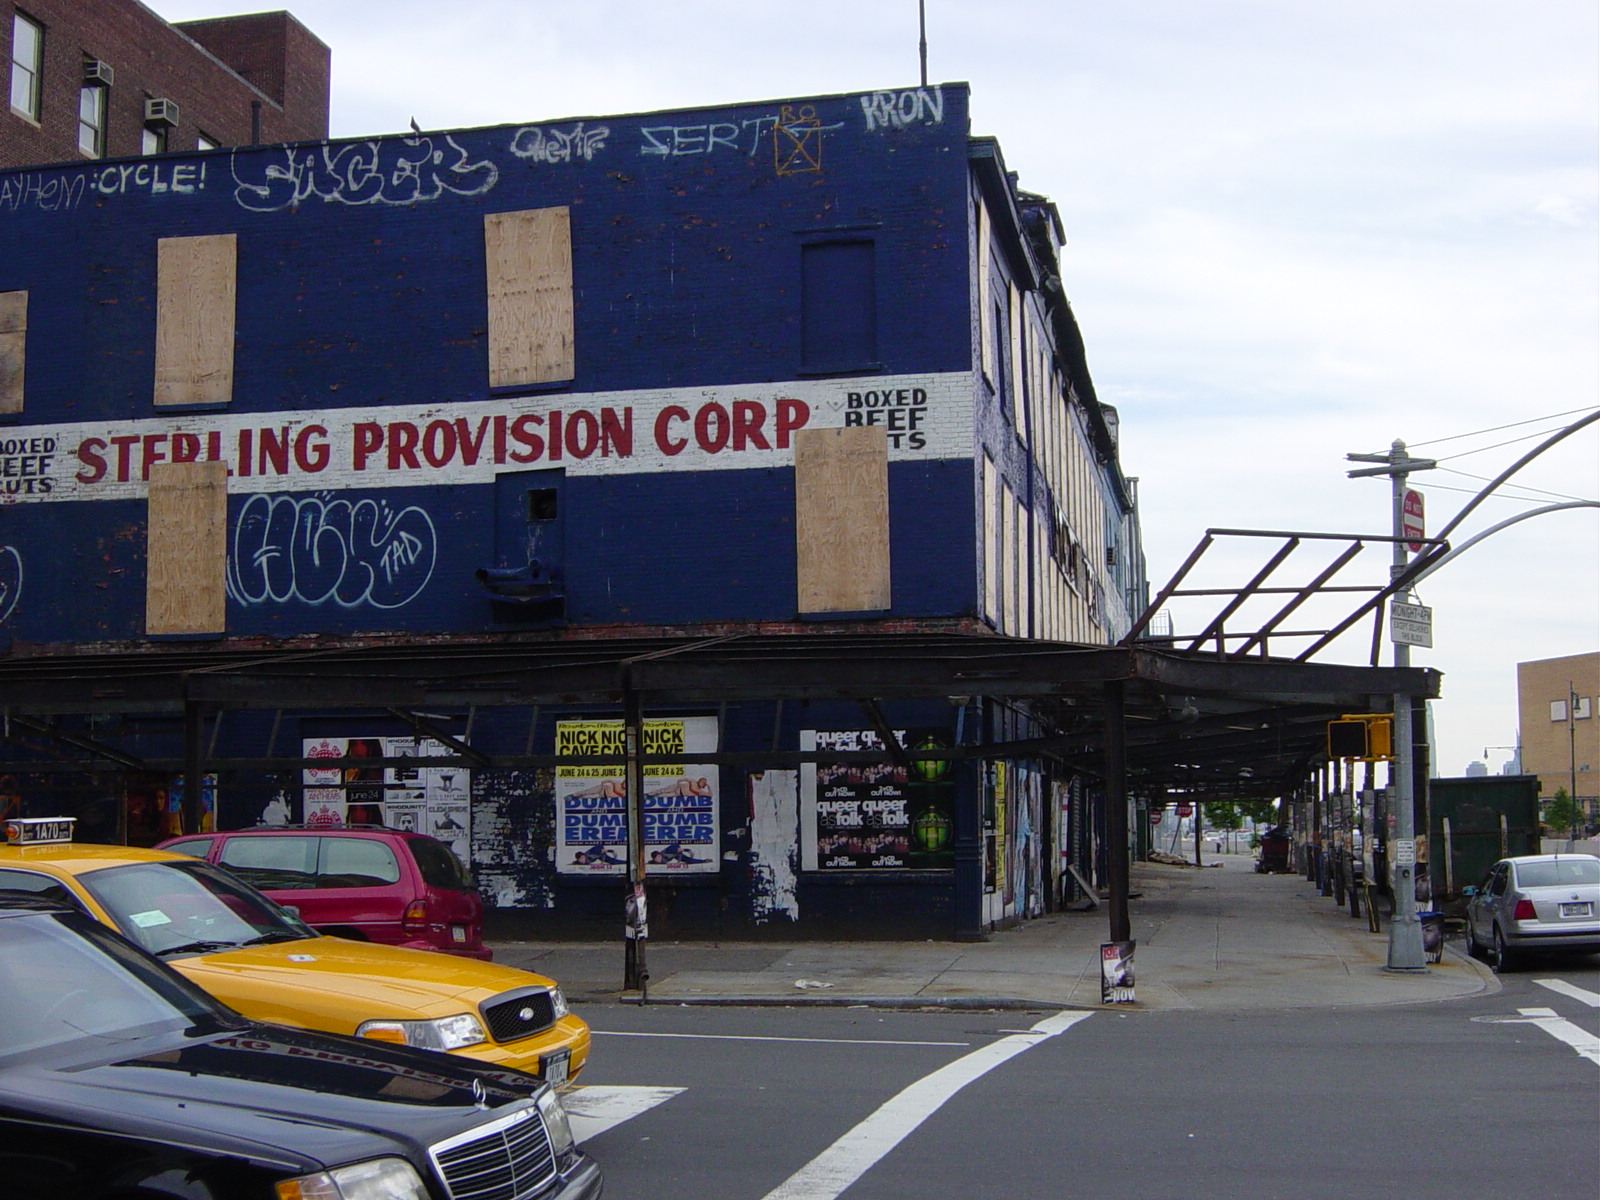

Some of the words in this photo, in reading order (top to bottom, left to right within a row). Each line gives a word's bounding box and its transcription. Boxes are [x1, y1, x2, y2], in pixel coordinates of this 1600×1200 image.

[860, 86, 944, 132] KRON
[847, 388, 928, 409] BOXED
[844, 407, 928, 431] BEEF
[75, 424, 331, 484] STERLING
[352, 406, 634, 472] PROVISION
[653, 398, 811, 456] CORP
[886, 431, 927, 450] TS
[0, 455, 55, 478] EEF
[0, 477, 56, 495] UTS
[560, 730, 599, 745] NICK
[601, 730, 626, 745] NIC
[643, 728, 684, 744] NICK
[816, 730, 860, 748] queer
[559, 744, 600, 756] CAVE
[644, 743, 684, 754] CAVE
[559, 768, 576, 777] JUNE
[577, 768, 585, 777] 24
[591, 768, 600, 777] 25
[601, 767, 617, 777] JUNE
[643, 767, 660, 776] JUNE
[661, 767, 670, 775] 24
[675, 766, 684, 775] 25
[644, 796, 713, 808] DUMB
[816, 801, 861, 816] queer
[862, 800, 907, 816] queer
[643, 813, 714, 826] DUMB
[836, 811, 863, 826] folk
[882, 811, 910, 825] folk
[36, 822, 59, 839] 1A70
[643, 825, 714, 841] ERER
